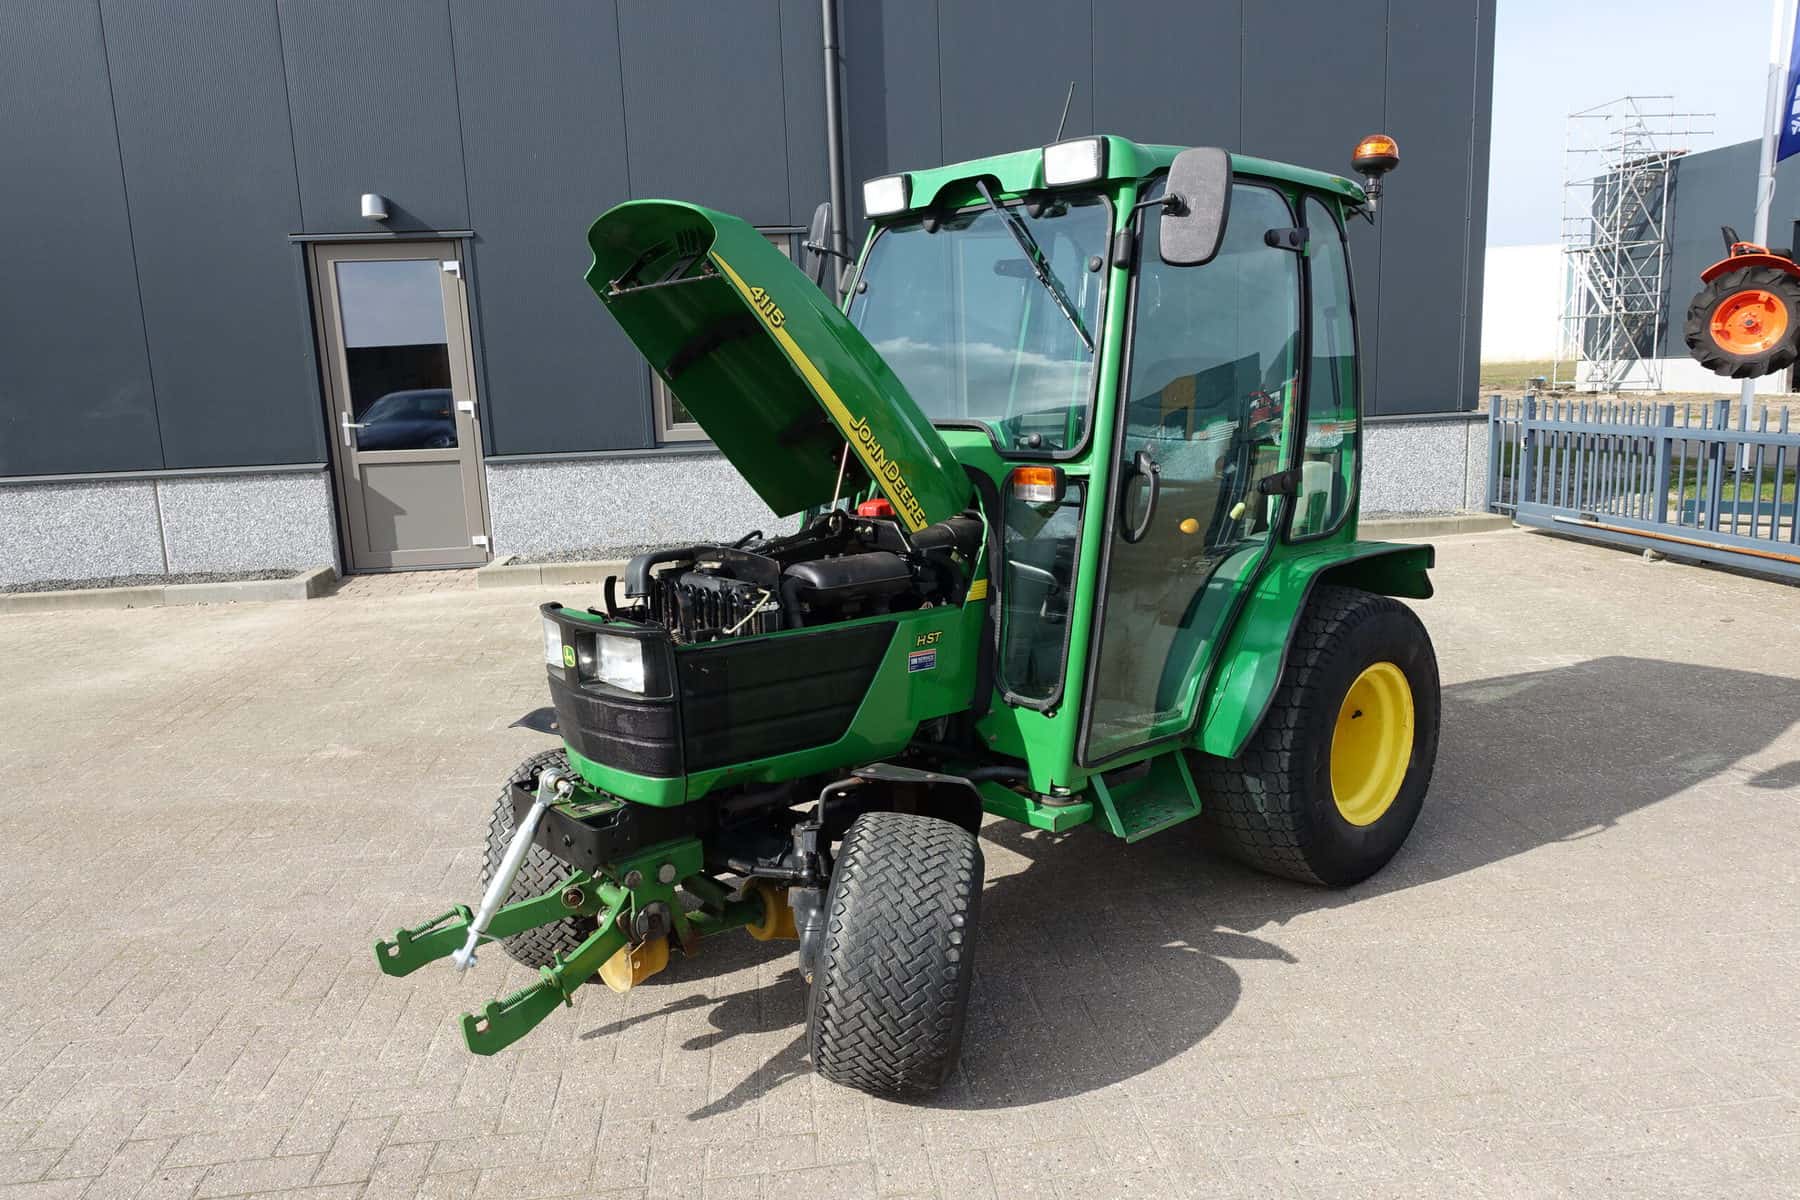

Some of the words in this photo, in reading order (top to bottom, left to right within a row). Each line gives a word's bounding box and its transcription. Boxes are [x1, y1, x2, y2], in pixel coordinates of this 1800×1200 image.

[750, 286, 785, 327] 4115
[849, 416, 888, 469] JOHN
[885, 461, 926, 527] DEERE
[916, 631, 942, 647] HST
